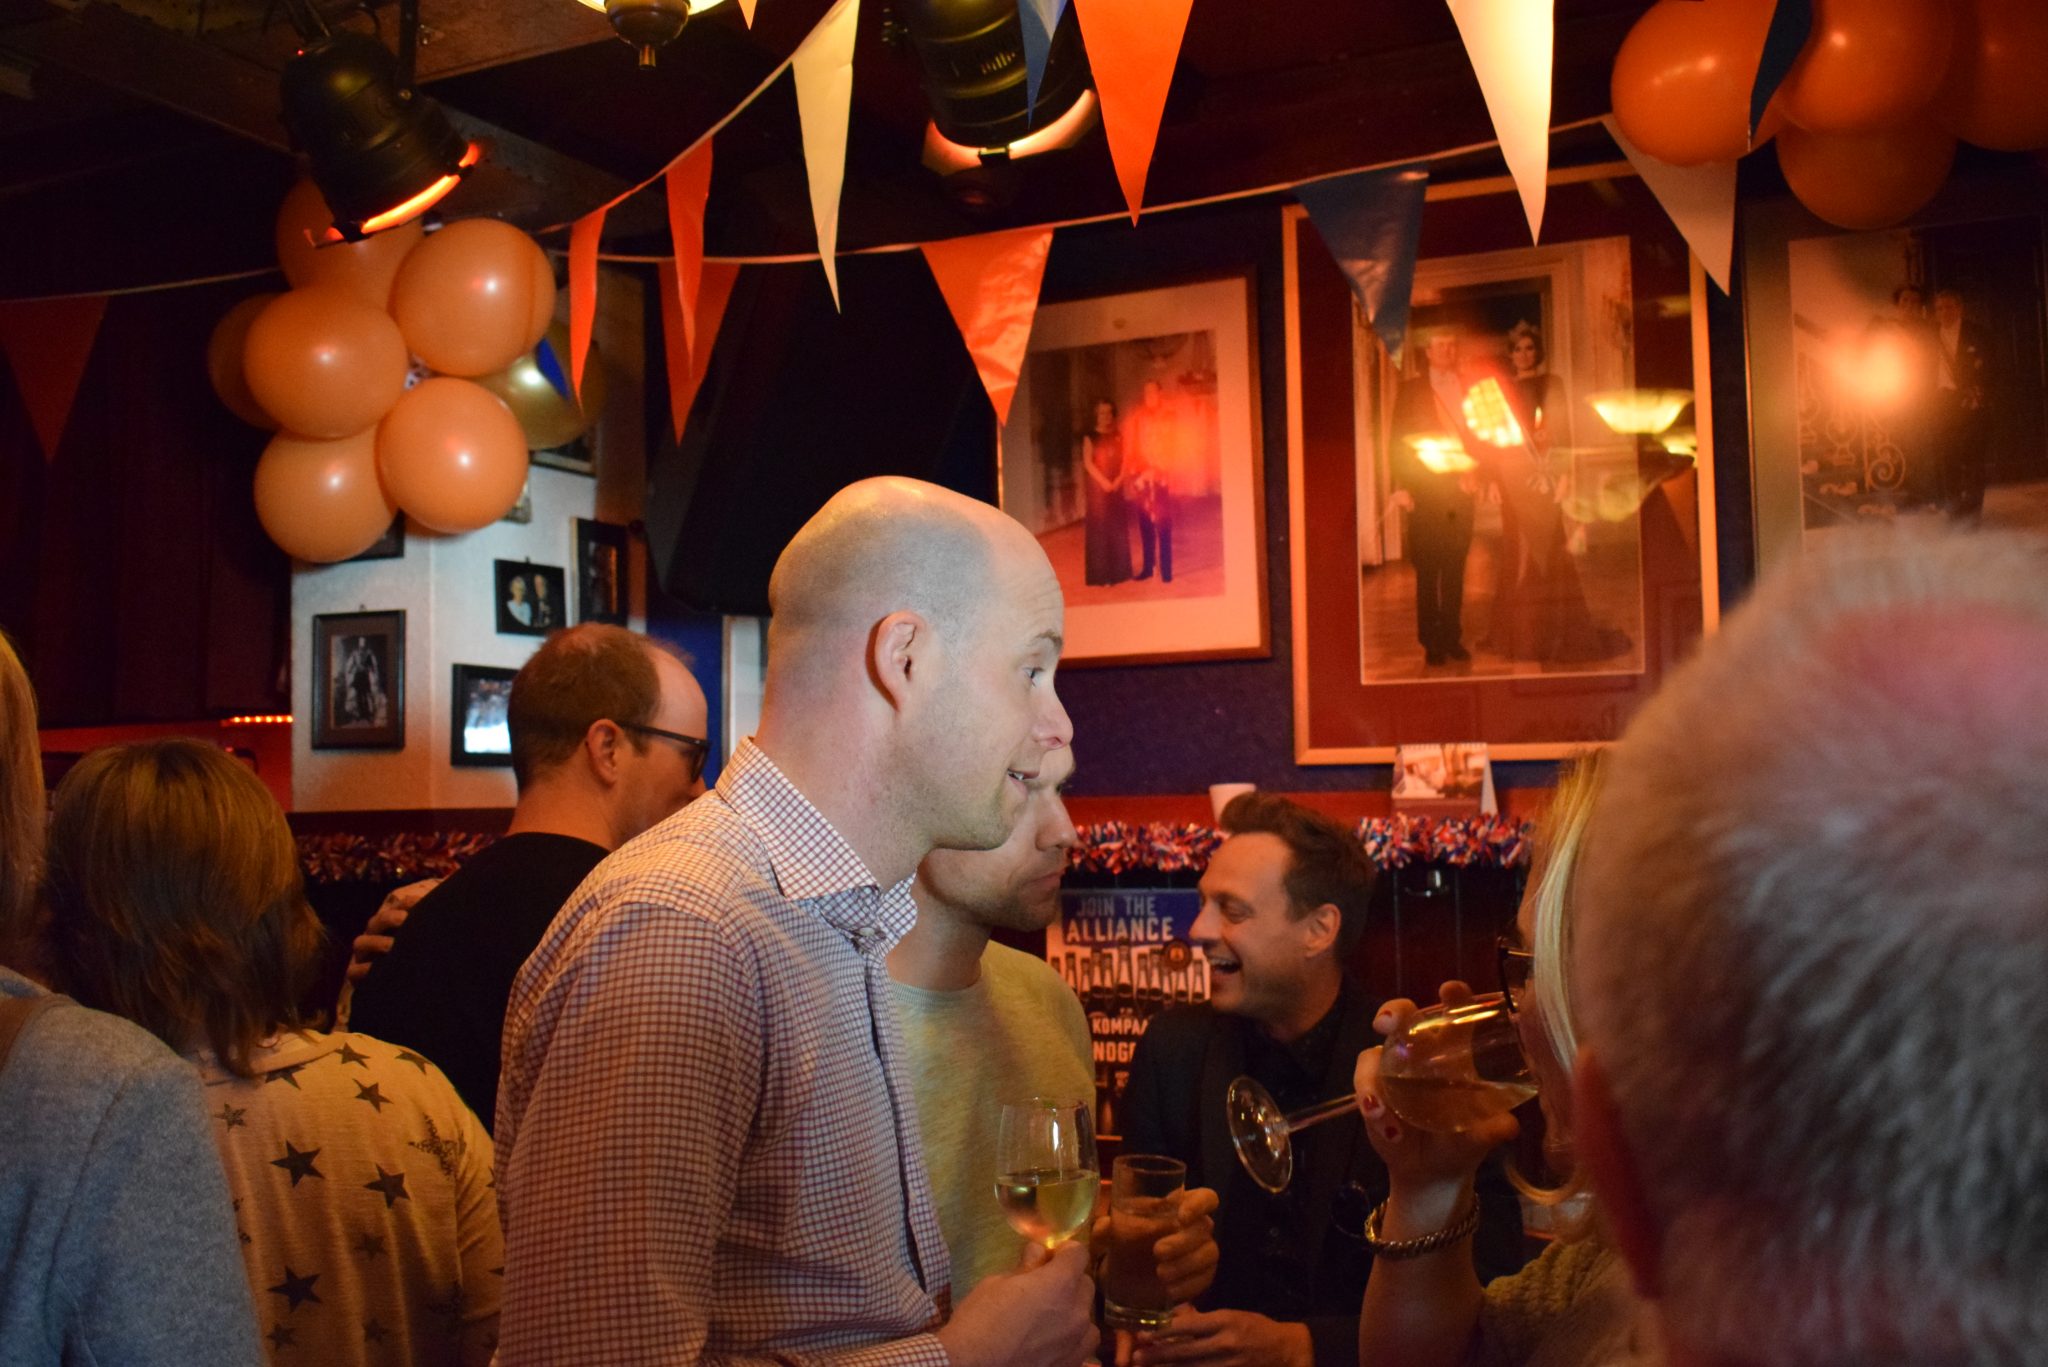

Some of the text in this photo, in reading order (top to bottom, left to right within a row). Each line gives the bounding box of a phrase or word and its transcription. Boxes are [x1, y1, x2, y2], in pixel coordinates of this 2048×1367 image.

[1077, 896, 1156, 916] JOIN THE
[1066, 917, 1174, 942] ALLIANCE
